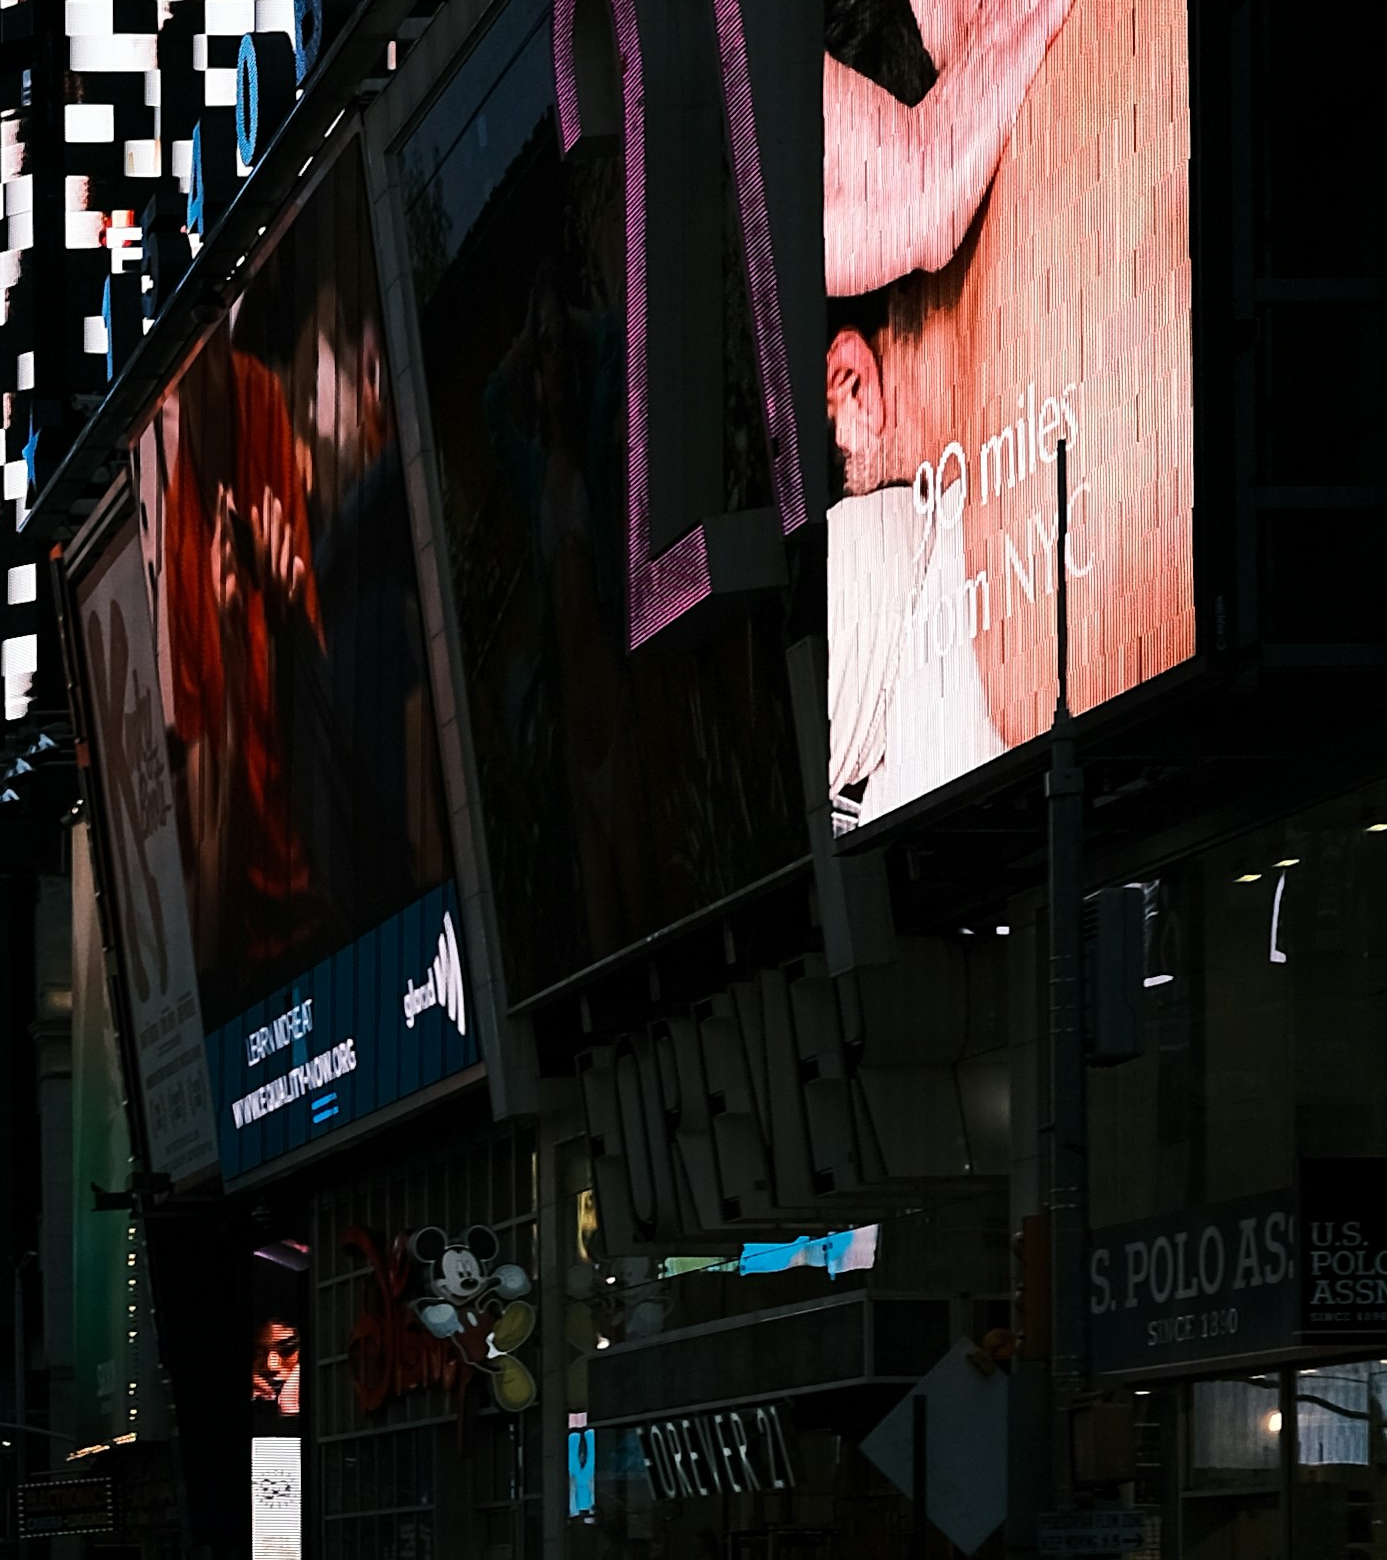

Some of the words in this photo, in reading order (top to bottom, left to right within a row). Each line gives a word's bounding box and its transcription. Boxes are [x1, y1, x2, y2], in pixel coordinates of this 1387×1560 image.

[980, 382, 1078, 505] miles
[1004, 482, 1096, 618] NYC
[1125, 1225, 1225, 1309] POLO
[1310, 1220, 1369, 1247] U.S.
[1146, 1314, 1195, 1346] SINCE
[636, 1410, 761, 1502] FOREVER
[756, 1404, 796, 1490] 21
